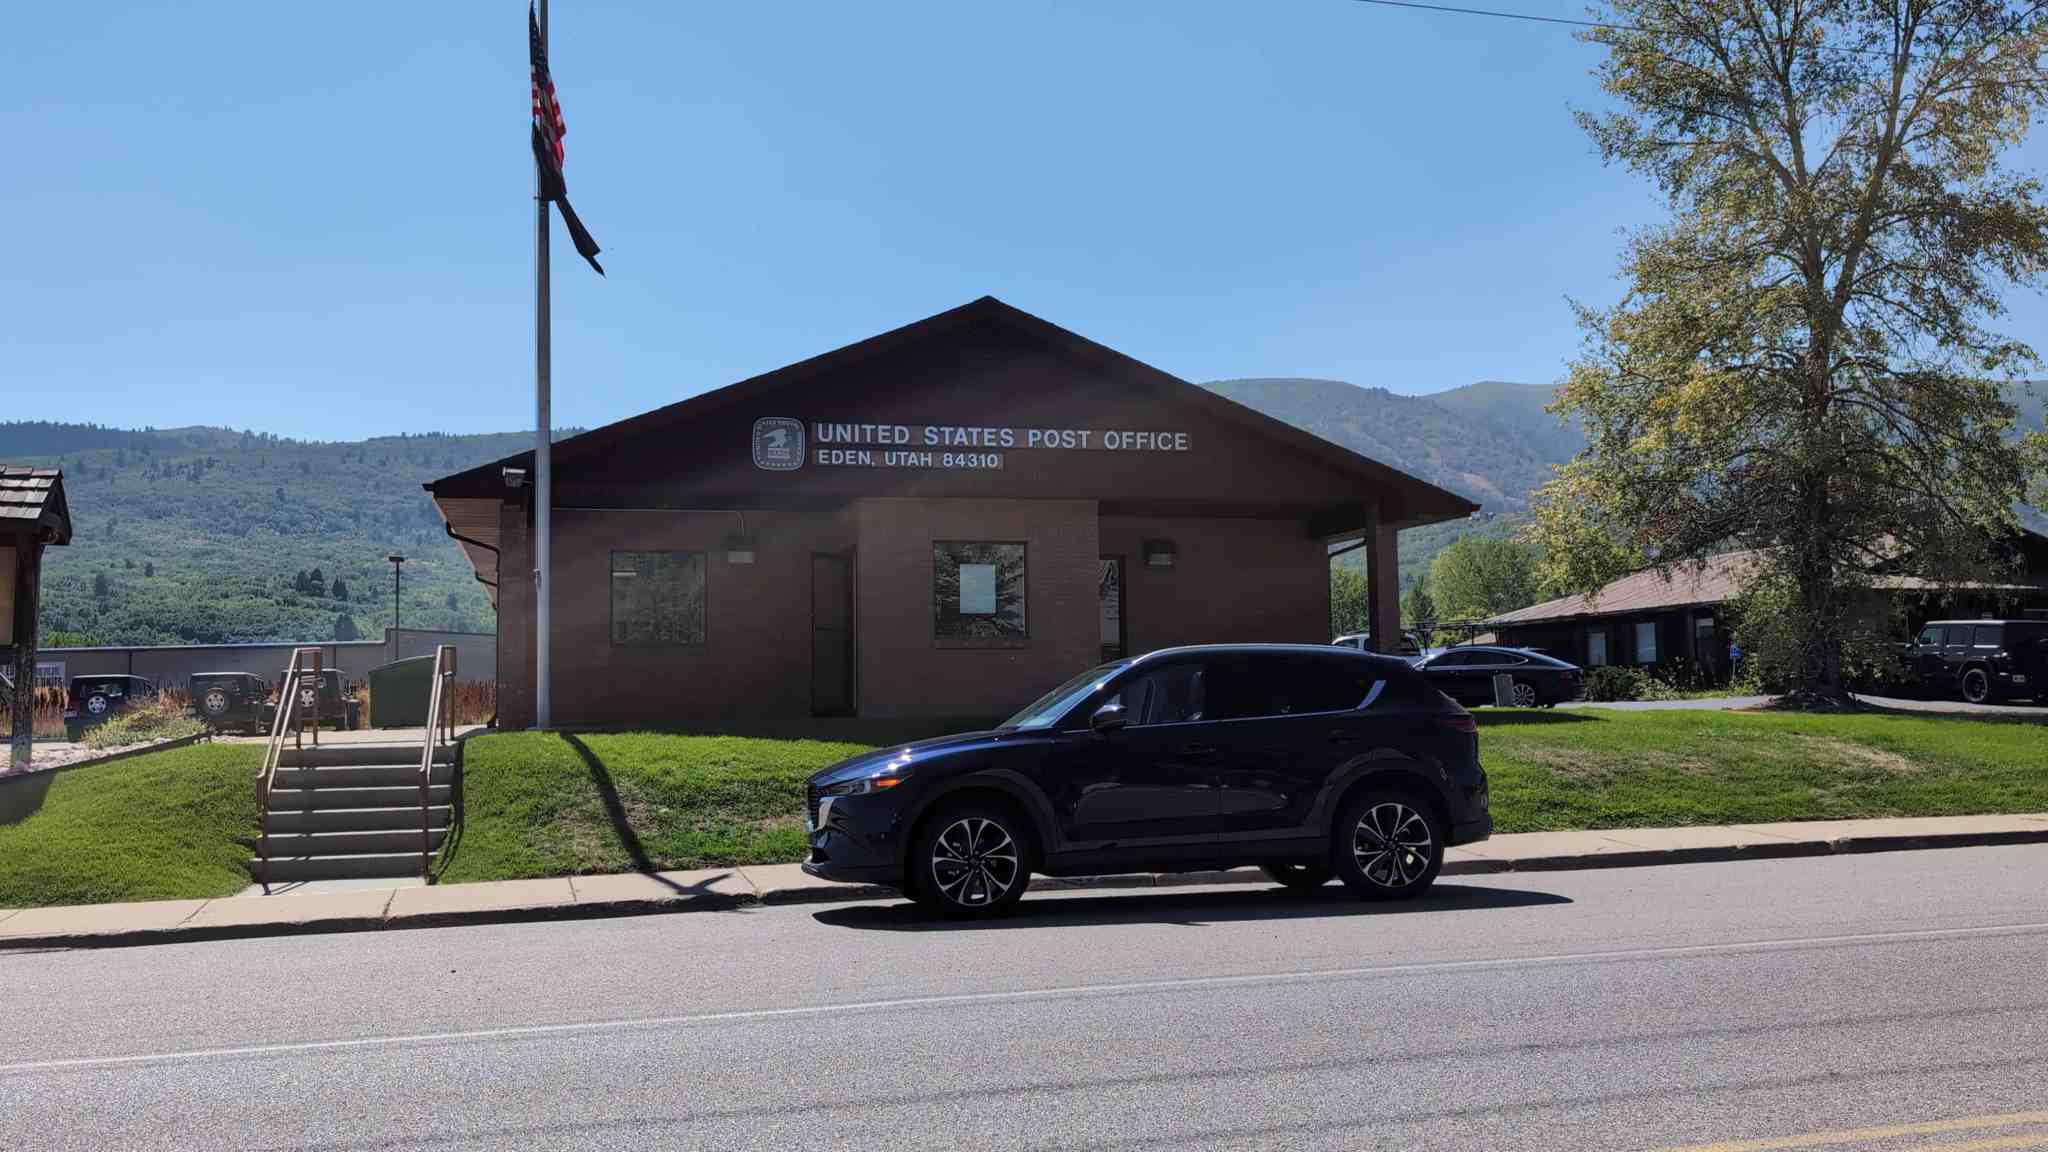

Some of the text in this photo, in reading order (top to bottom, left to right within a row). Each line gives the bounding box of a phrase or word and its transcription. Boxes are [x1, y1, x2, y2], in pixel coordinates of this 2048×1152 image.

[817, 423, 910, 445] UNITED
[923, 425, 1015, 447] STATES
[1028, 428, 1091, 449] POST
[1103, 430, 1188, 451] OFFICE
[884, 451, 932, 467] UTAH
[943, 452, 998, 468] 84310
